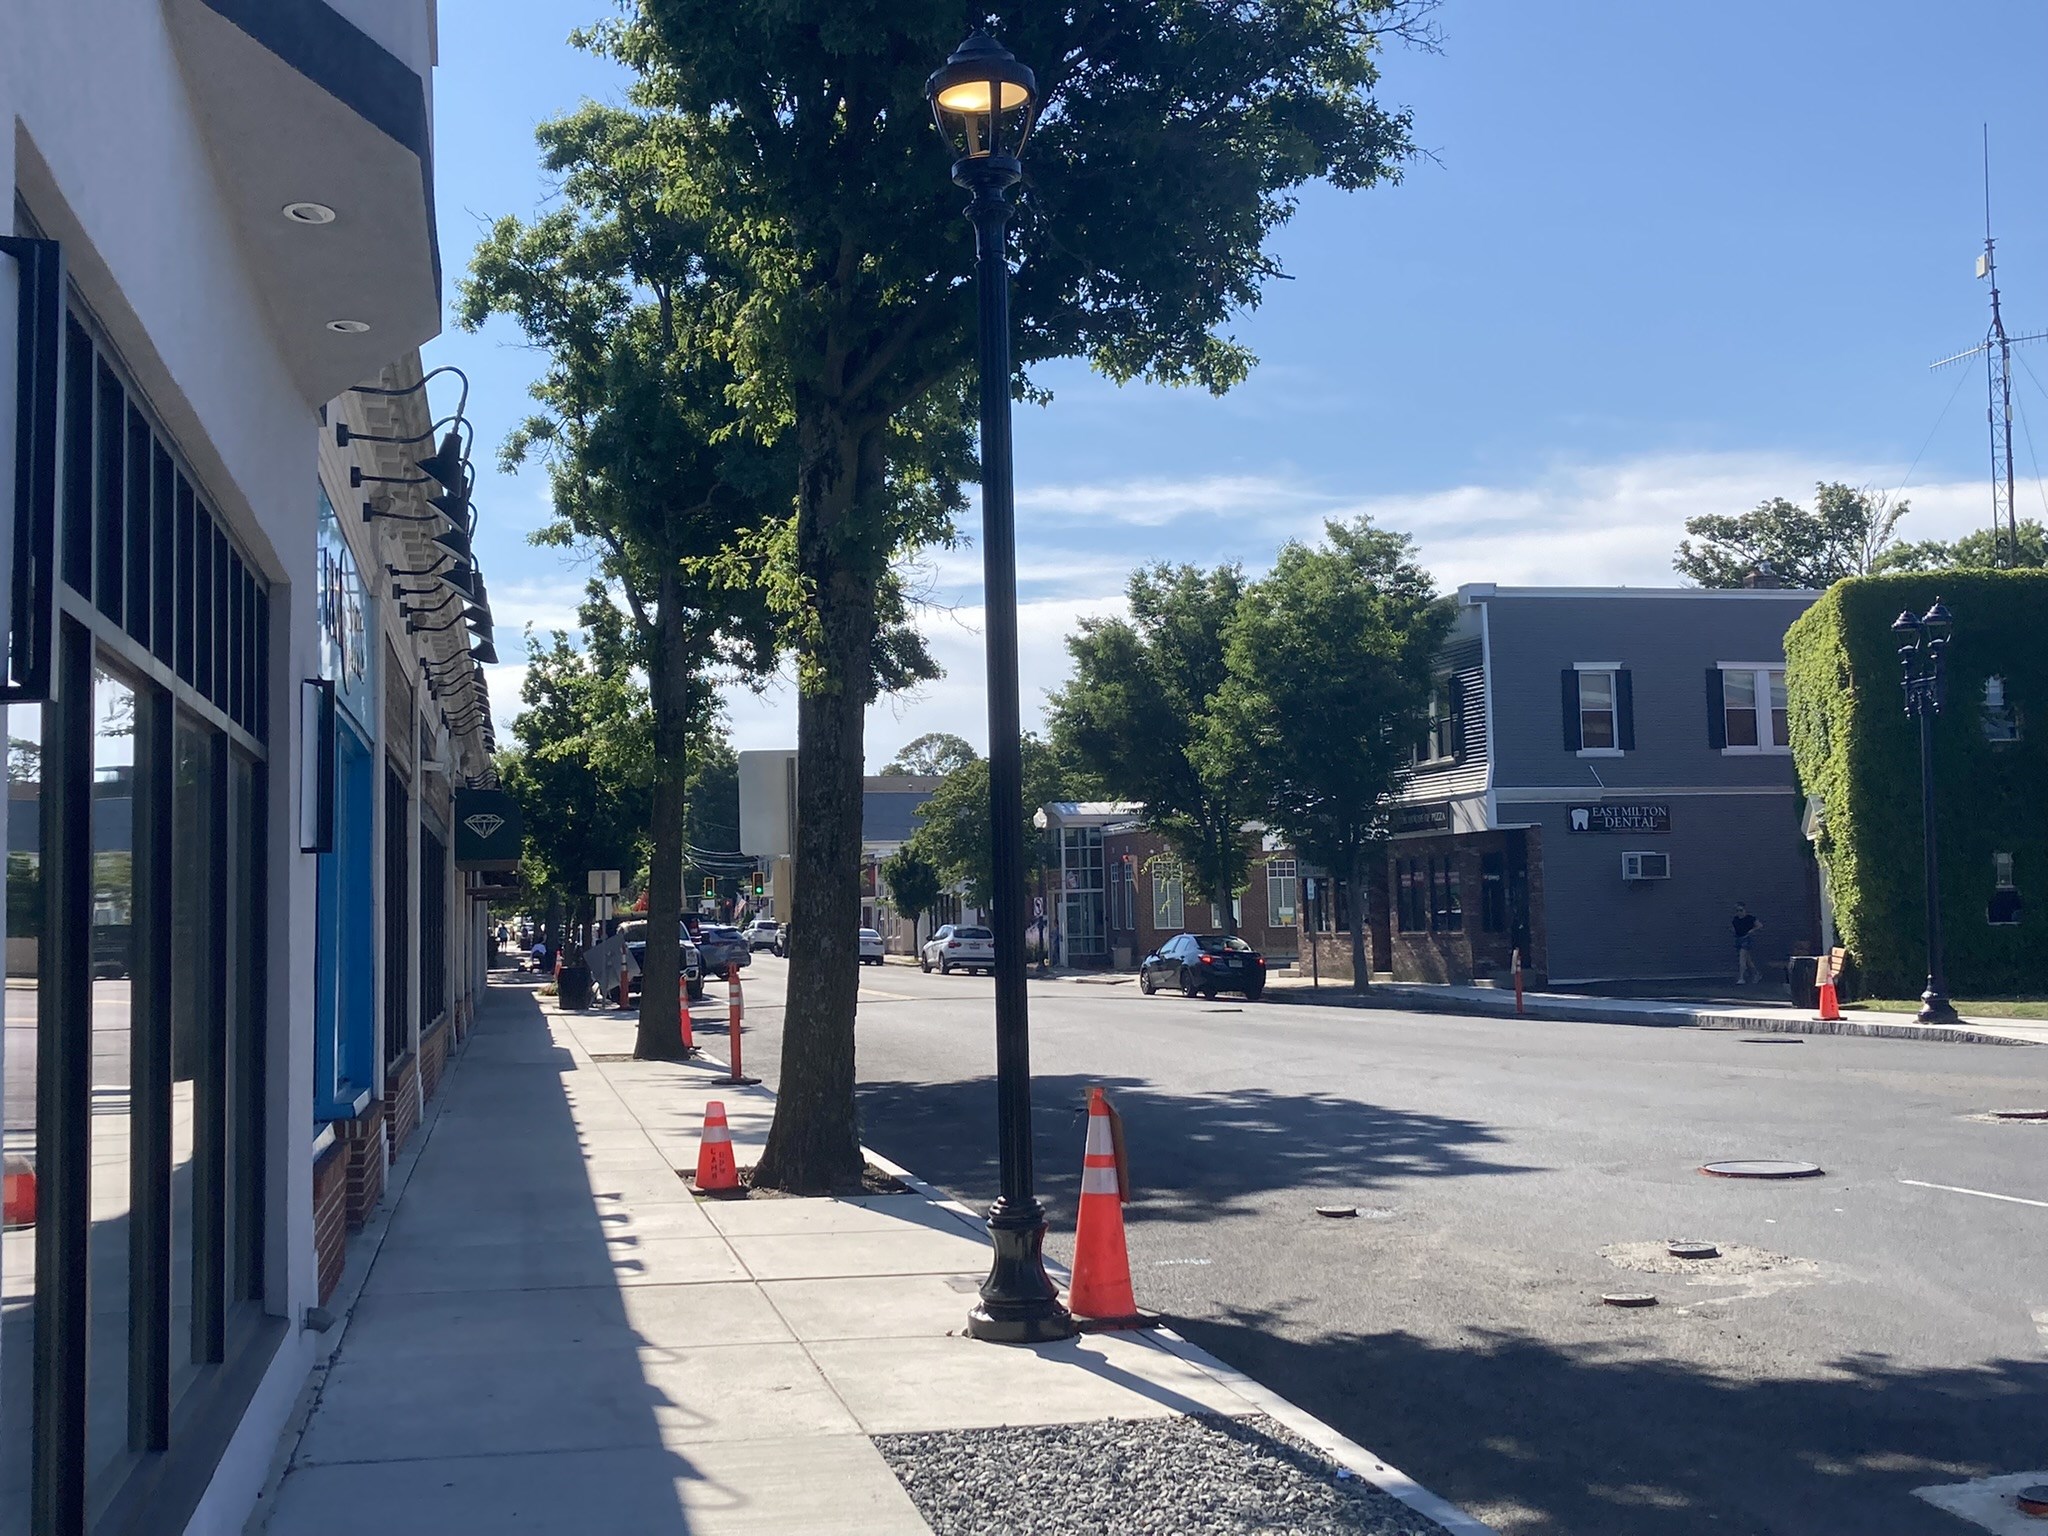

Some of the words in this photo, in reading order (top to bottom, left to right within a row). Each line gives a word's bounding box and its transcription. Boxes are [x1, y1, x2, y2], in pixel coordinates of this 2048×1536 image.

[1431, 811, 1446, 821] PIZZA
[1592, 807, 1619, 816] EAST
[1621, 806, 1667, 816] MILTON
[1604, 816, 1658, 828] DENTAL
